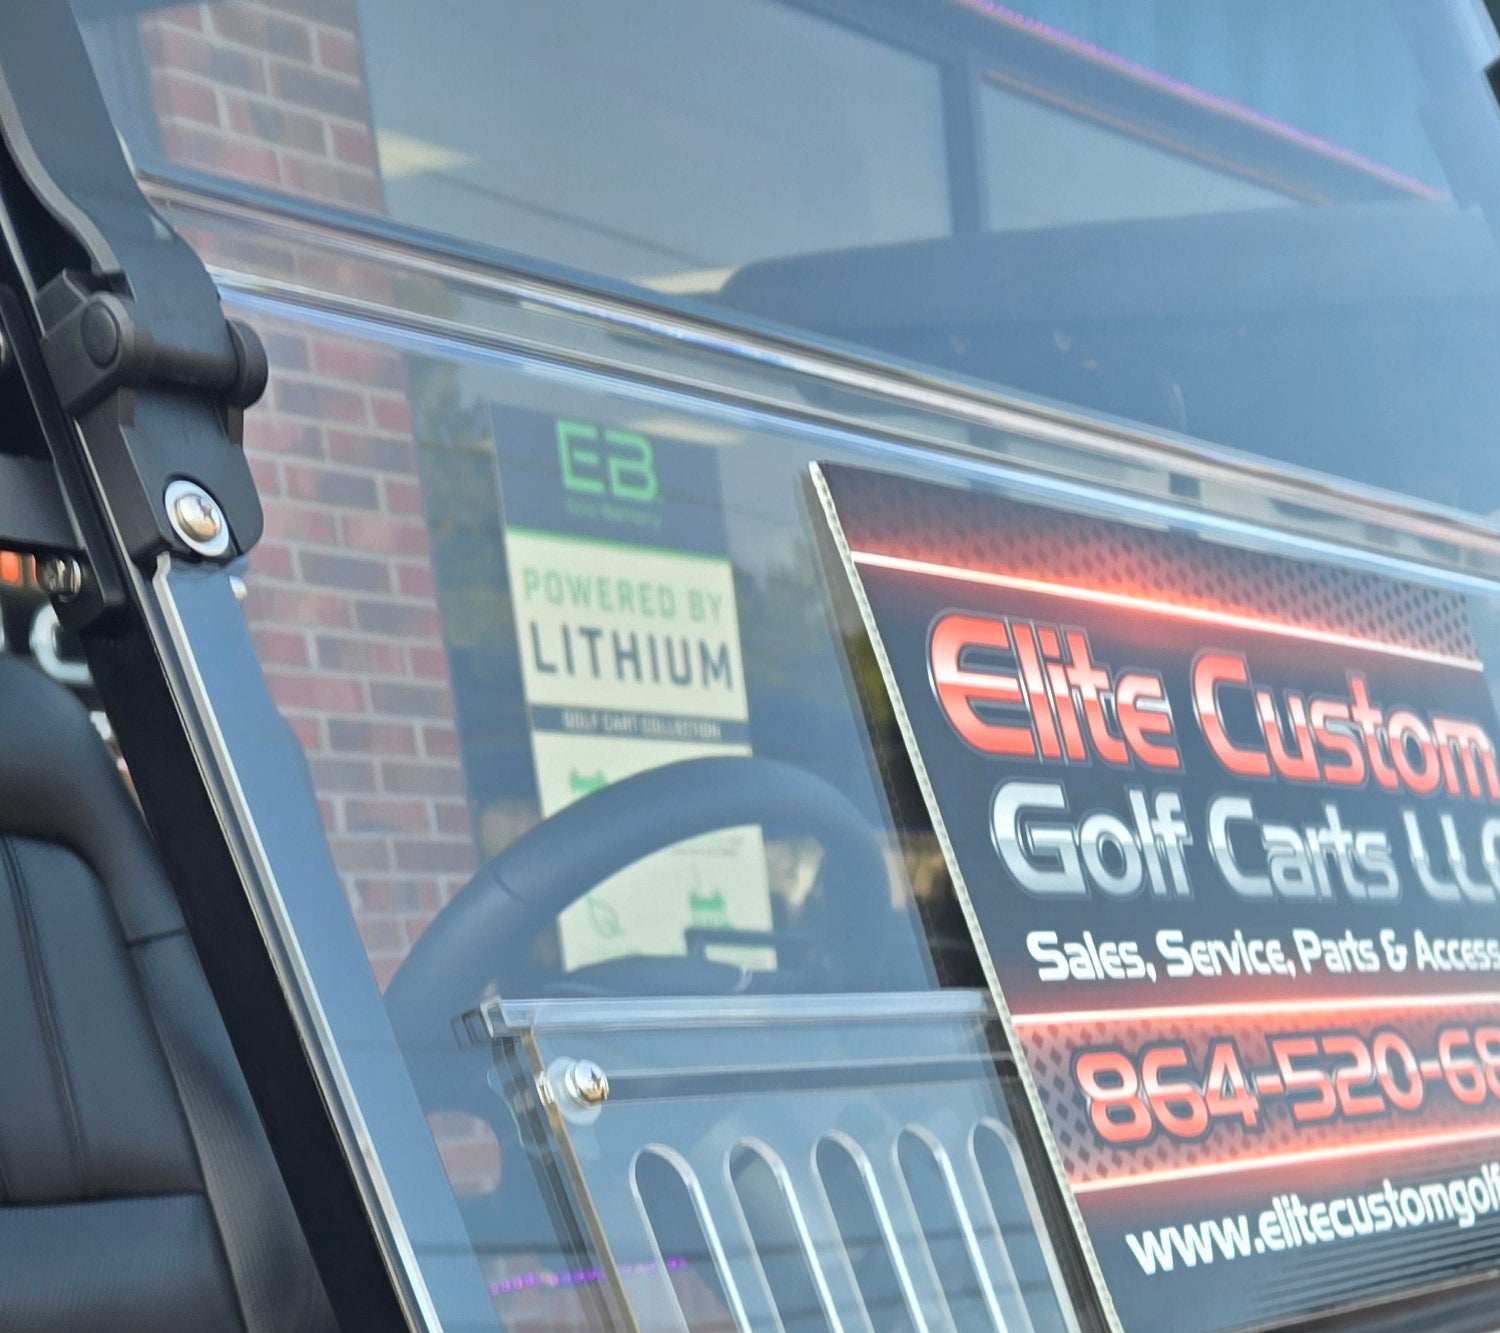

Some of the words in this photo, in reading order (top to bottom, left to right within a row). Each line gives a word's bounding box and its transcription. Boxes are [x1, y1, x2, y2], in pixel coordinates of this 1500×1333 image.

[523, 567, 676, 618] POWERED
[688, 588, 724, 622] BY
[530, 620, 735, 690] LITHIUM
[929, 608, 1184, 774] Elite
[990, 781, 1194, 899] Golf
[1208, 793, 1400, 902] Carts
[1026, 930, 1157, 982] Sales,
[1159, 930, 1298, 979] Service,
[1301, 928, 1376, 973] Parts
[1381, 933, 1409, 973] &
